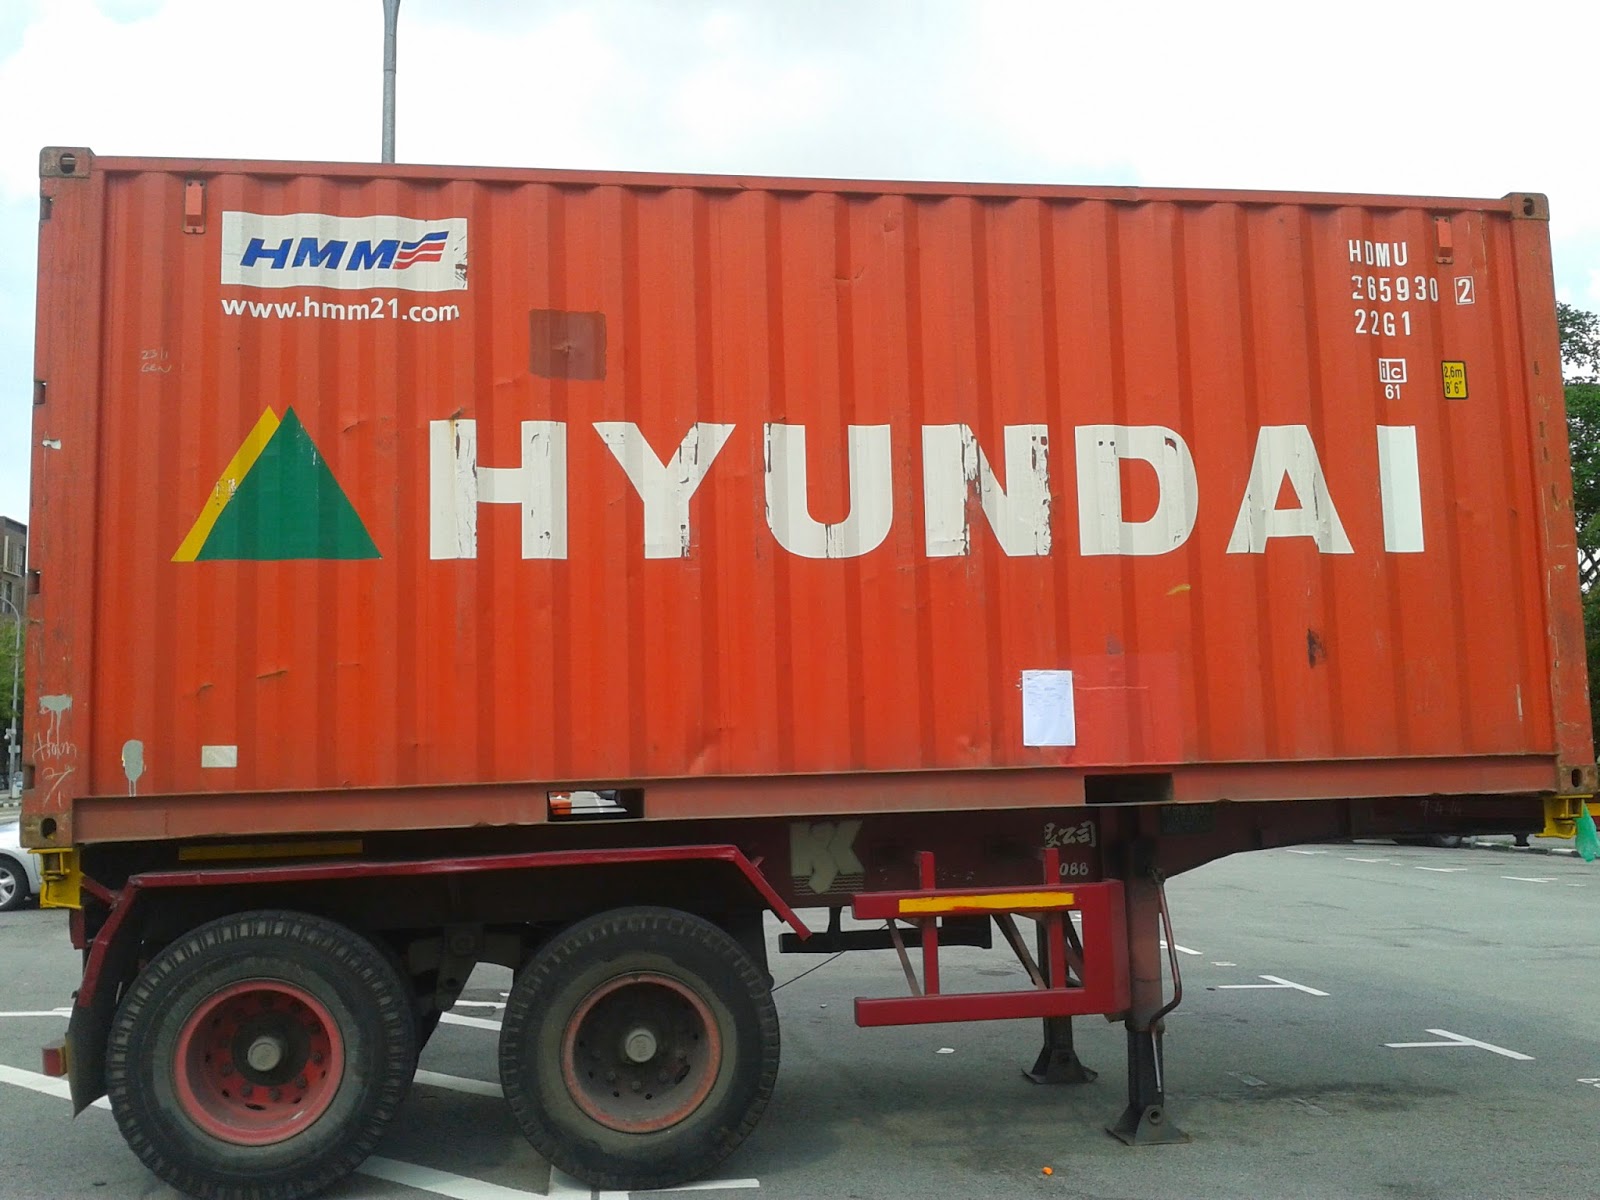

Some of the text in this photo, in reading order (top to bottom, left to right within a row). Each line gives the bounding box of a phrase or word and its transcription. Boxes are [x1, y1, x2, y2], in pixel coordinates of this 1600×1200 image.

[240, 237, 400, 271] HMM
[1349, 240, 1408, 267] HDMU
[1351, 275, 1473, 303] 265930 2
[221, 296, 460, 323] www.hmm21.com
[1354, 309, 1411, 337] 22G1
[1385, 384, 1401, 400] 61
[429, 418, 1426, 561] HYUNDAI
